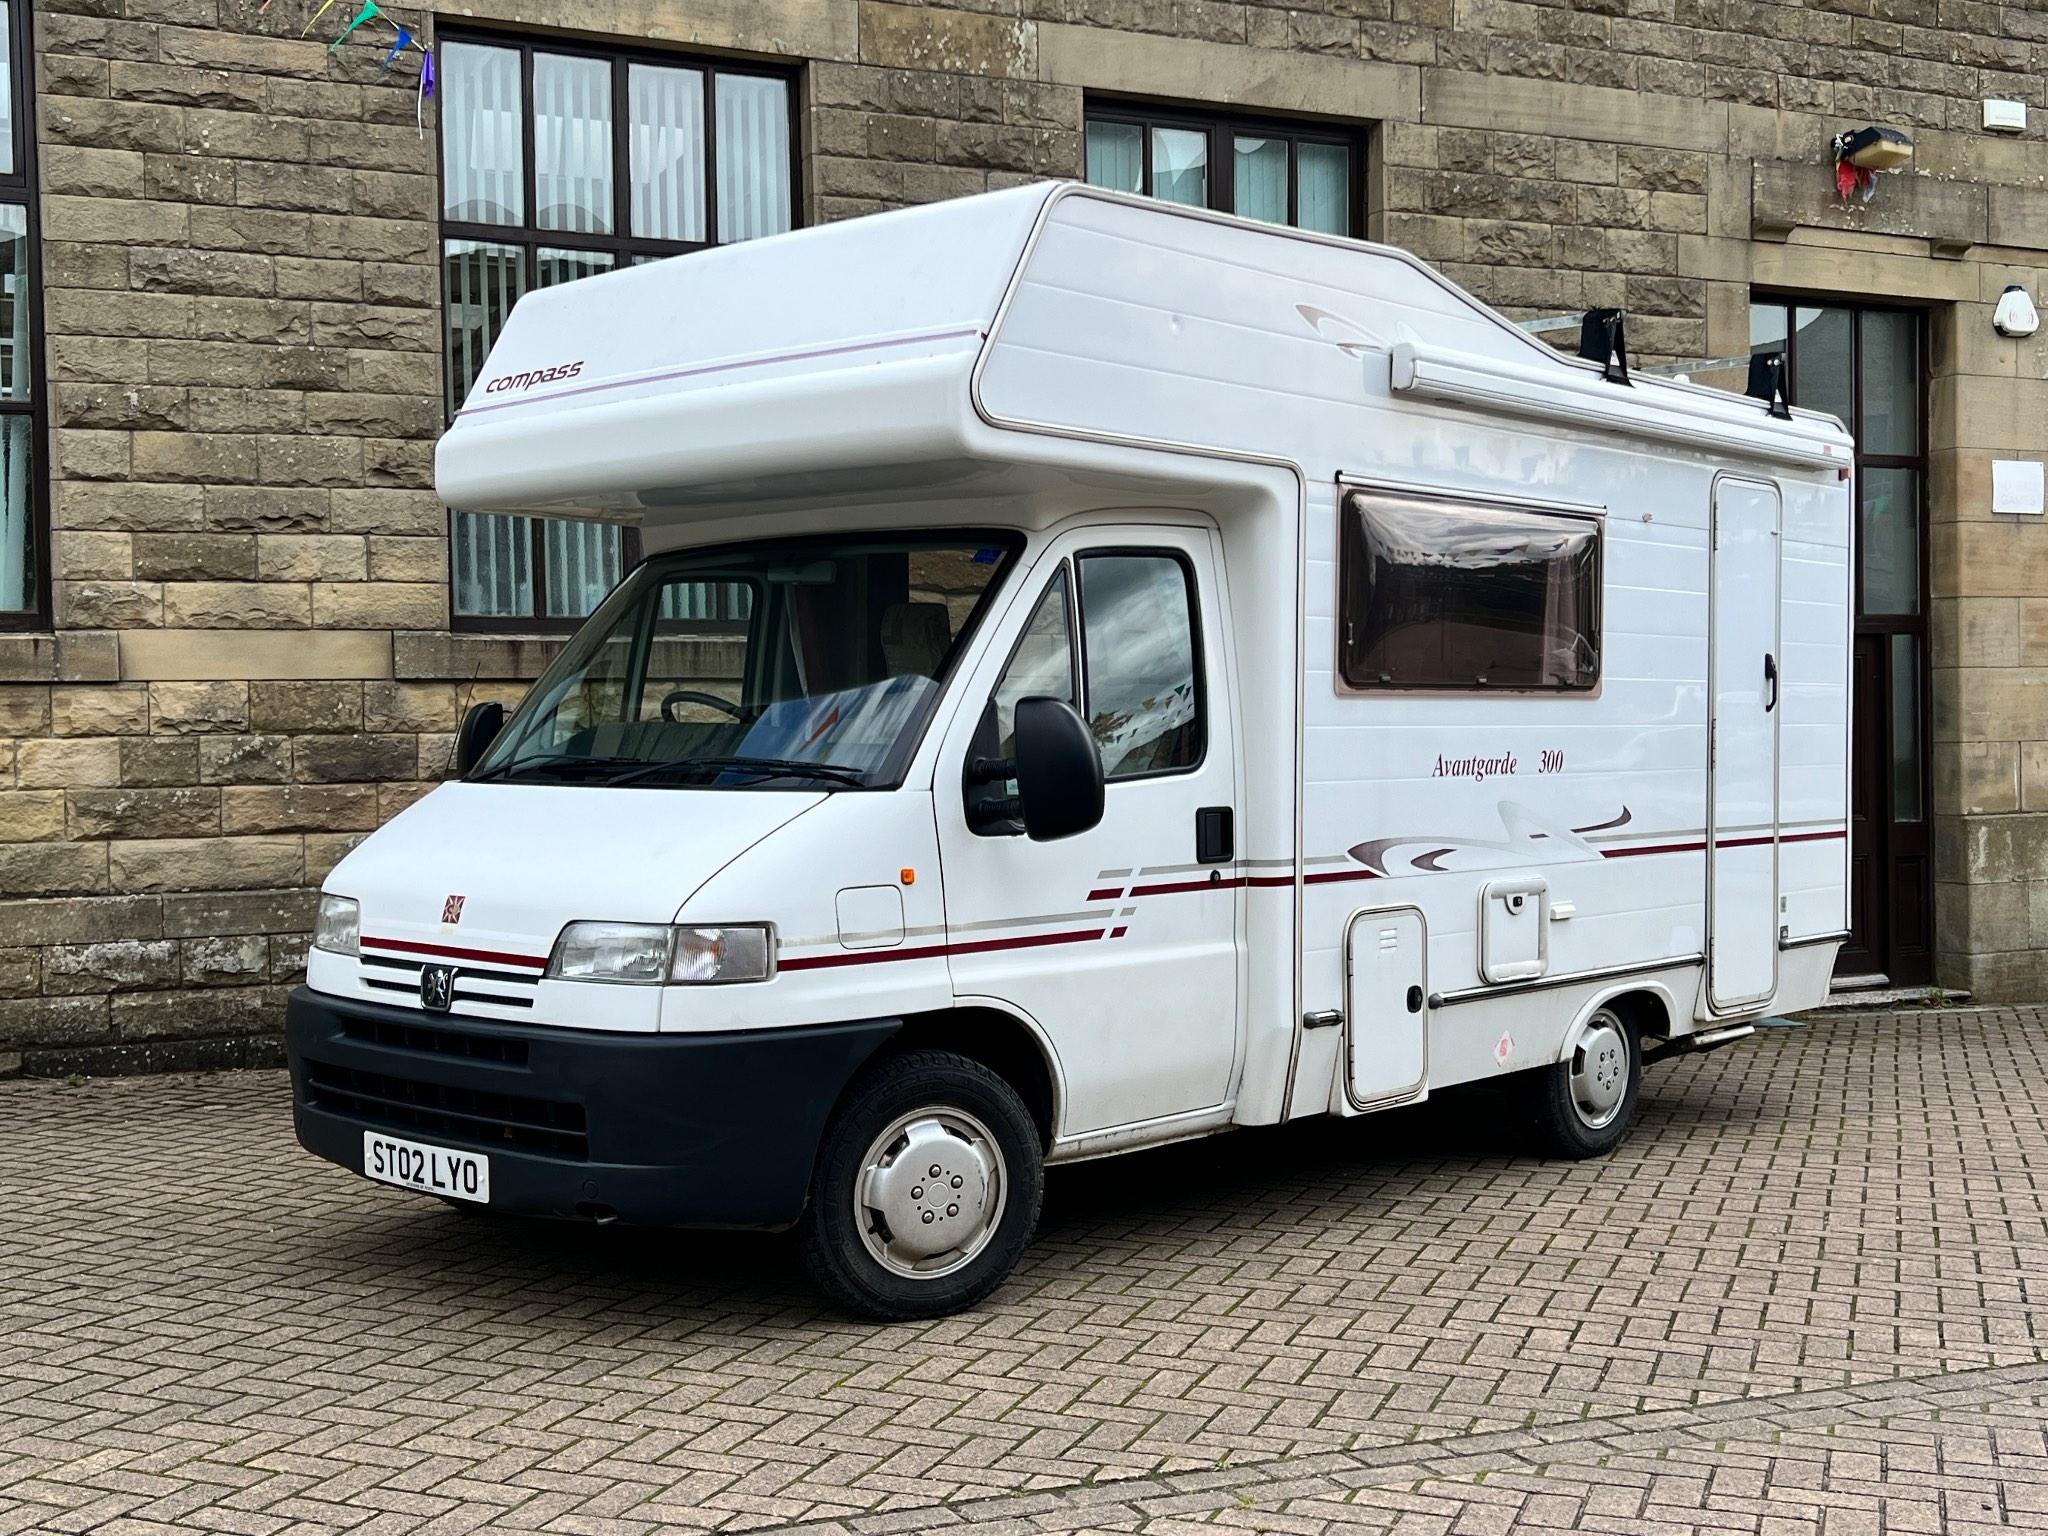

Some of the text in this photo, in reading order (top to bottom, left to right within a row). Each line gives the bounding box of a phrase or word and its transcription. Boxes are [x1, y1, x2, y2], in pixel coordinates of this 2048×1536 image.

[486, 361, 584, 393] compass
[1432, 750, 1564, 782] Avantgarde 300
